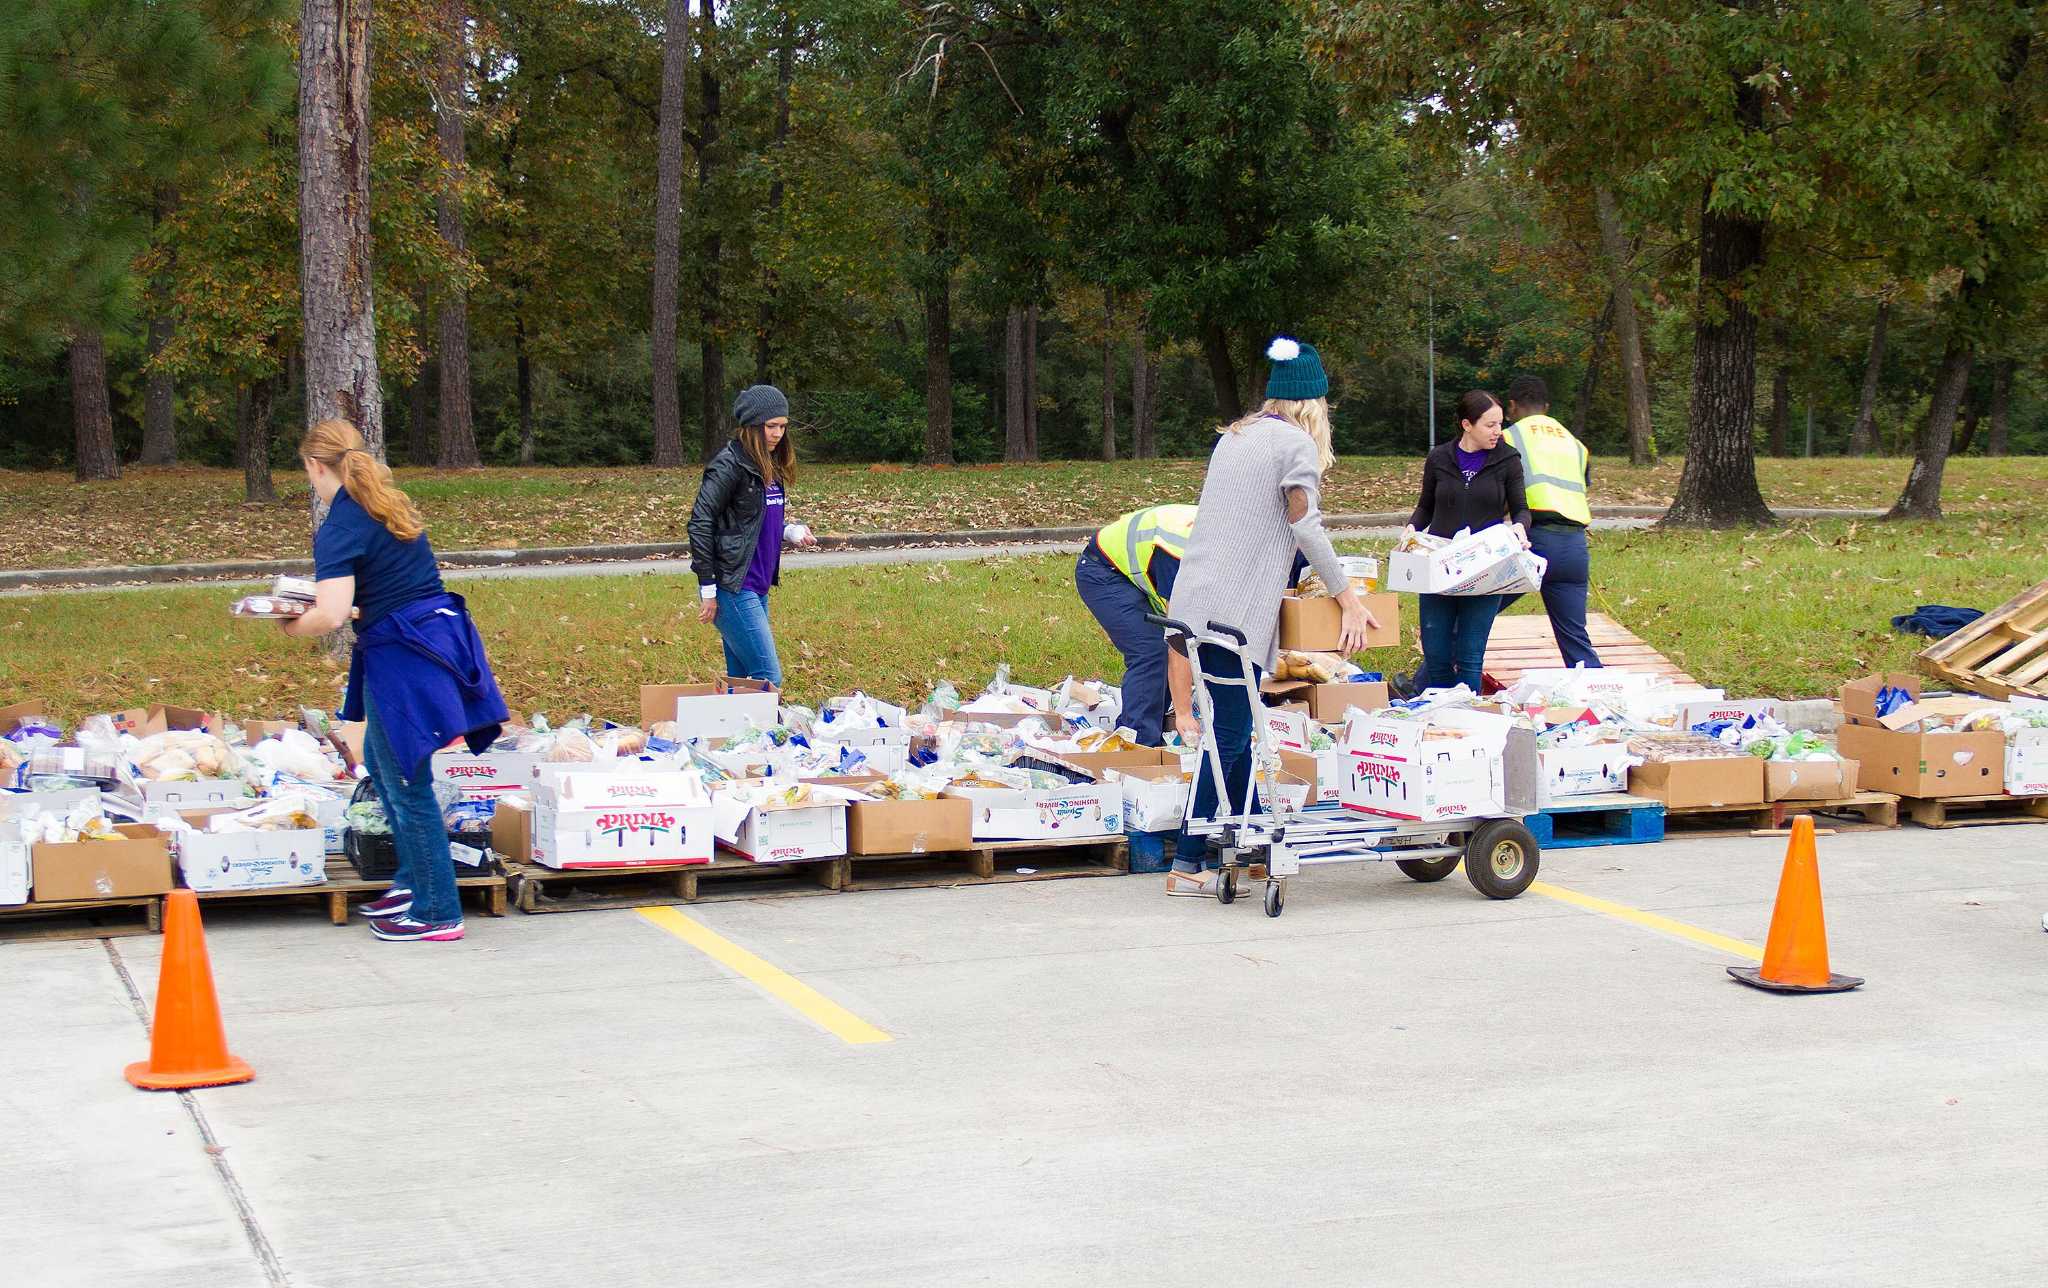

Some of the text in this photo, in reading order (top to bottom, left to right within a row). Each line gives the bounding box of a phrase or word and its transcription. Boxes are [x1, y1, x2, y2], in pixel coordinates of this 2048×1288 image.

[1530, 424, 1566, 438] FIRE
[1369, 731, 1398, 744] PRIMA
[445, 766, 498, 778] PRIMA
[1357, 761, 1401, 783] PRIMA
[1435, 803, 1468, 815] PRIMA
[596, 812, 676, 833] PRIMA
[770, 847, 805, 857] PRIMA
